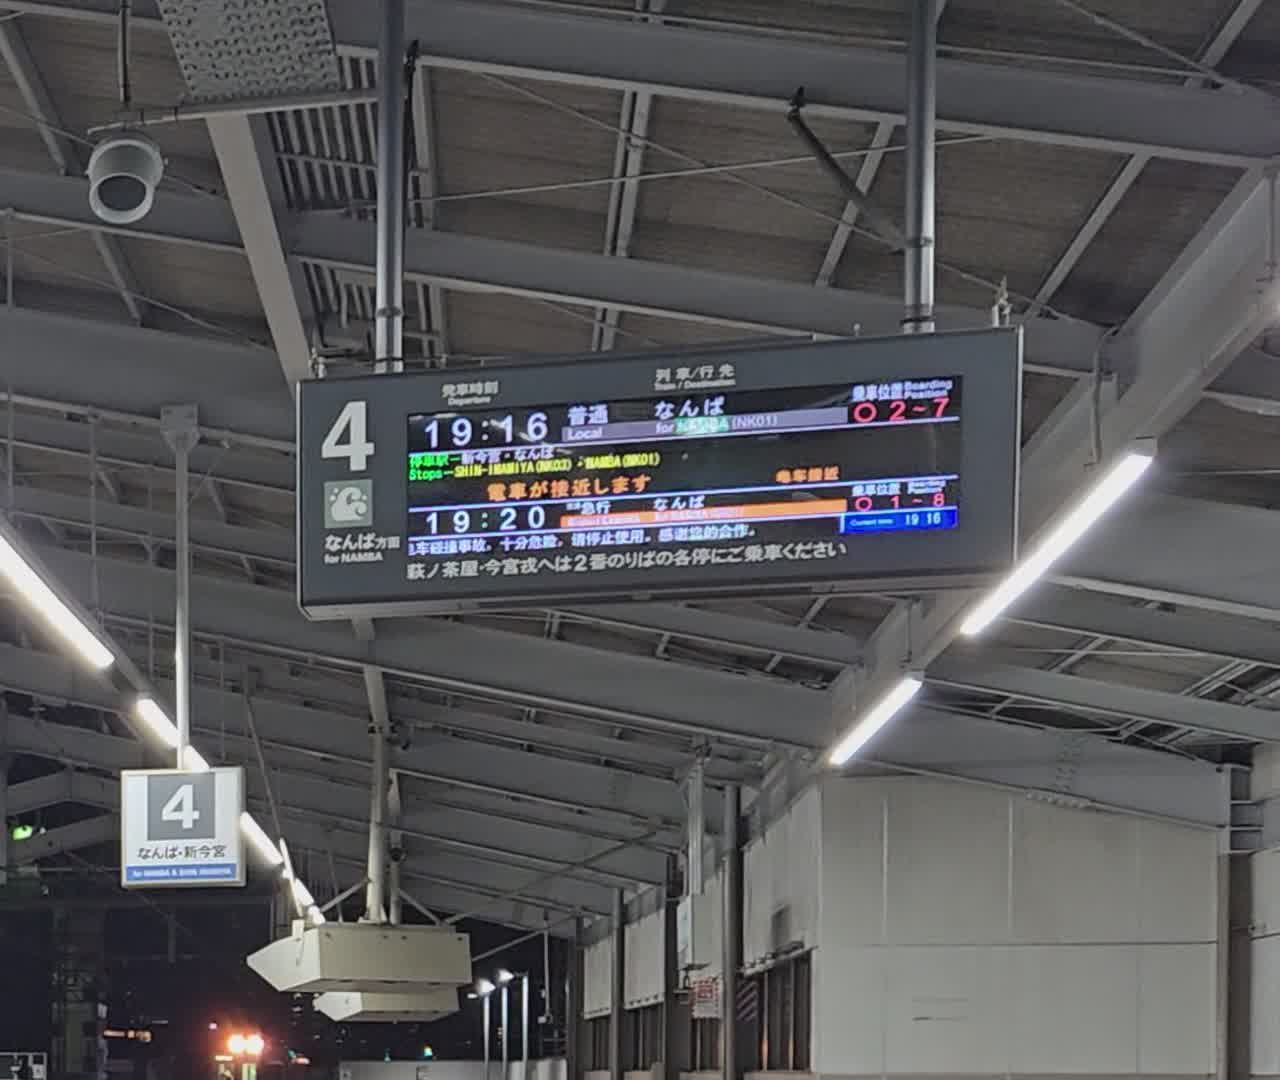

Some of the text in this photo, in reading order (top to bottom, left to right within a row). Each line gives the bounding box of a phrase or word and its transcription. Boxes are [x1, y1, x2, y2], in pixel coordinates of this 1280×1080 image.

[567, 403, 609, 426] 普通
[654, 396, 726, 420] なんば
[321, 401, 375, 471] 4
[424, 412, 549, 449] 19:16
[567, 427, 603, 441] Local
[655, 421, 674, 435] for
[487, 474, 652, 502] 電車が接近します
[653, 494, 705, 511] なんば
[425, 505, 546, 535] 19:20
[324, 532, 401, 552] なんば方面
[324, 551, 384, 565] for NAMBA
[161, 783, 200, 830] 4
